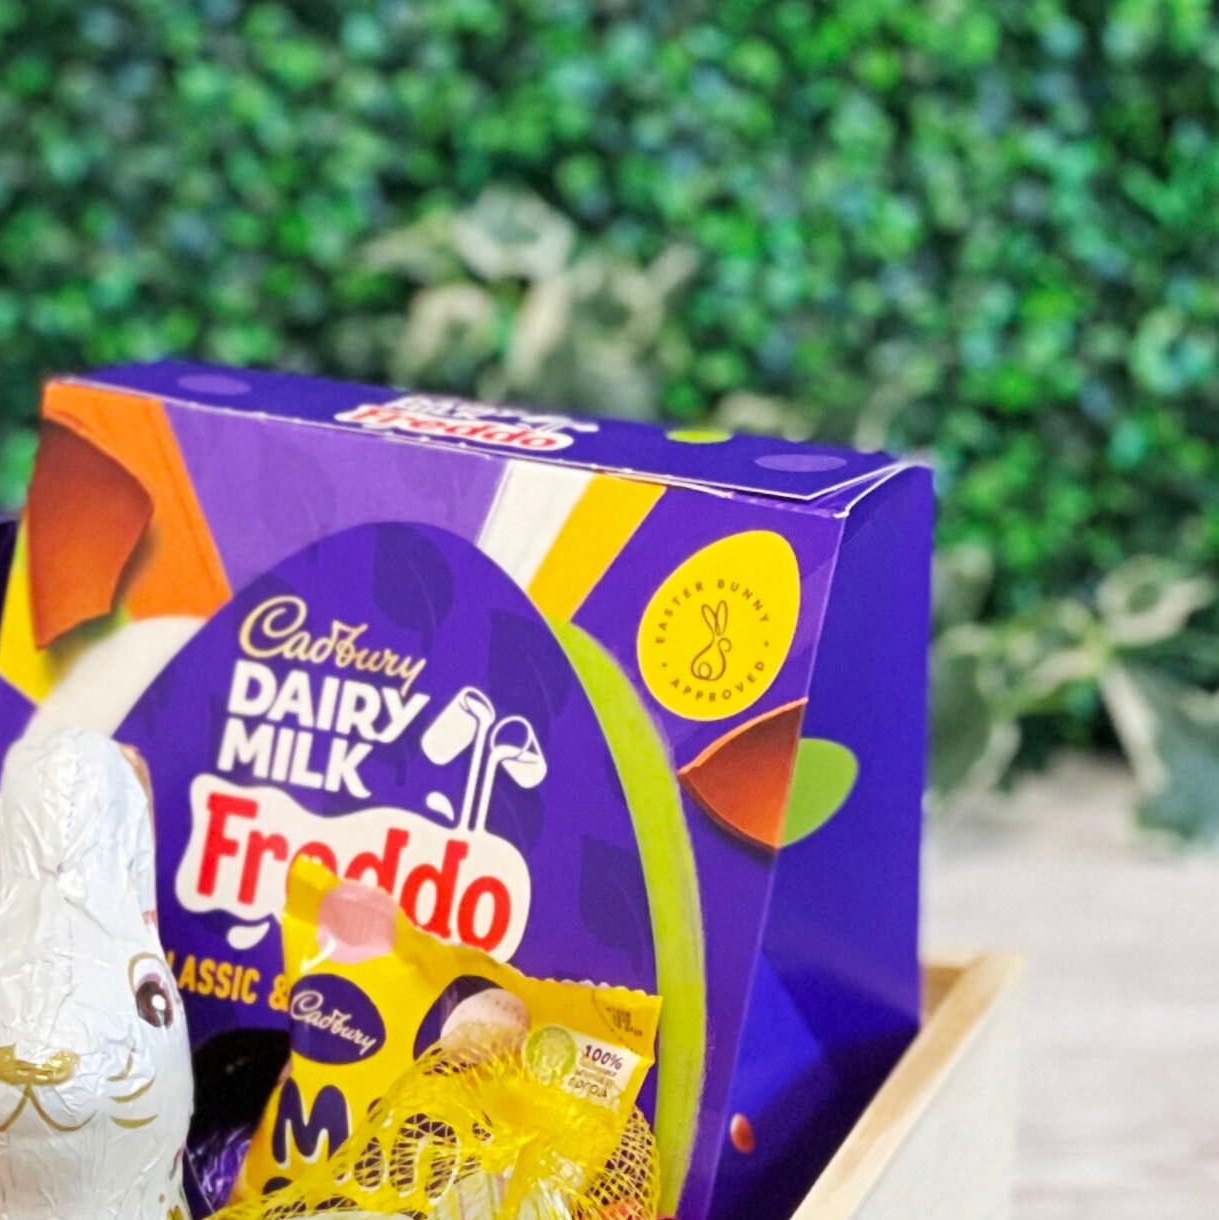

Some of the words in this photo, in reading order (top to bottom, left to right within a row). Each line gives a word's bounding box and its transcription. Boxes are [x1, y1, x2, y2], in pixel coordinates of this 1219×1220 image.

[350, 407, 558, 448] Freddo
[655, 581, 705, 644] EASTER
[717, 578, 770, 624] BUNNY
[238, 594, 428, 698] Cadbury
[227, 659, 431, 744] DAIRY
[670, 660, 766, 702] APPROVED
[216, 716, 373, 799] MILK
[167, 951, 260, 1005] ASSIC
[290, 990, 377, 1056] Cadbury
[585, 1044, 623, 1071] 100%
